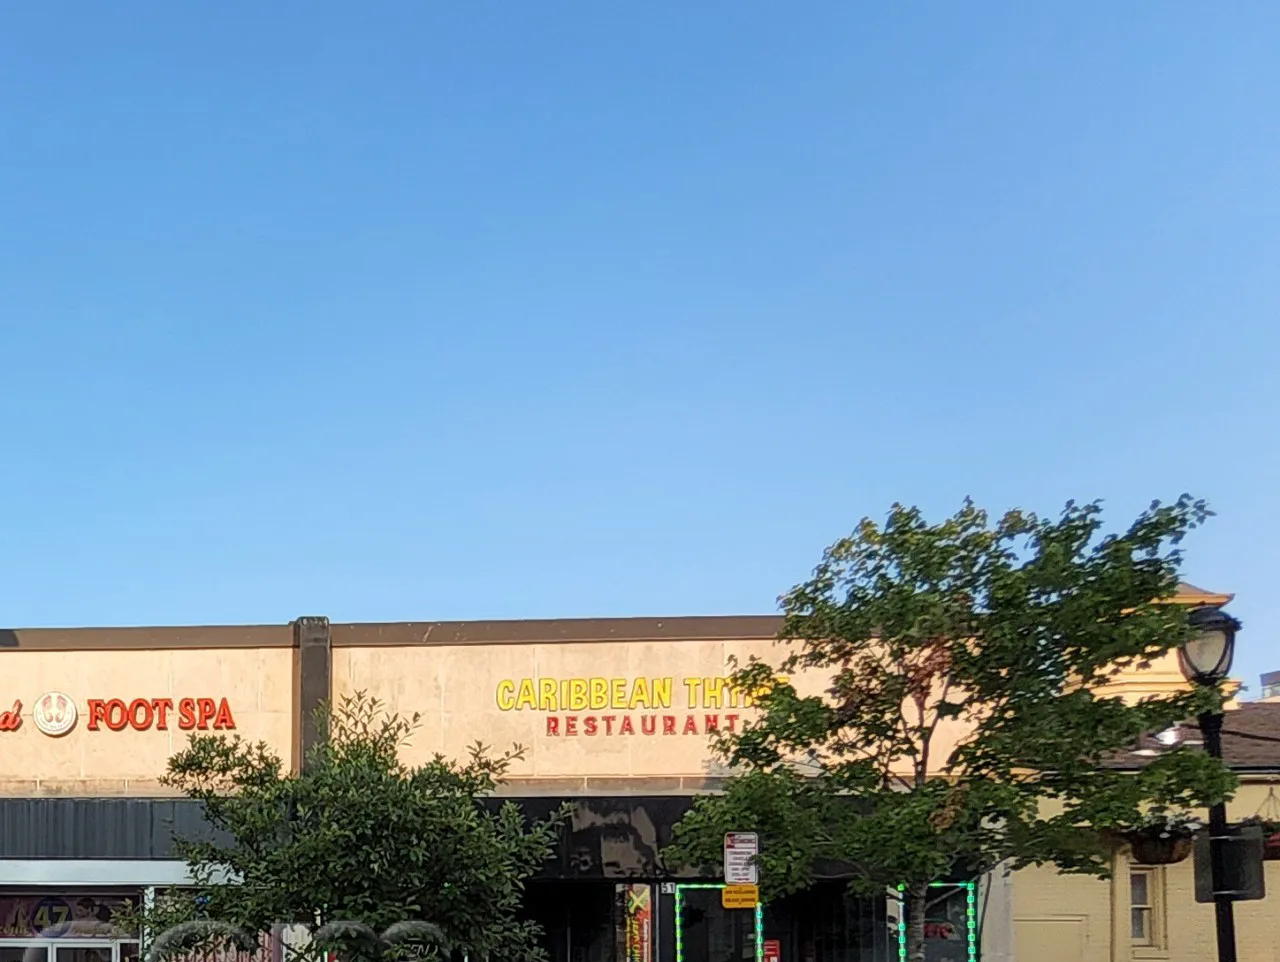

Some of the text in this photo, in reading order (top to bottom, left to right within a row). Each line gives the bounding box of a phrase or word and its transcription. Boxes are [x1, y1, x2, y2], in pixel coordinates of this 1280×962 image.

[496, 677, 673, 712] CARIBBEAN
[87, 697, 237, 730] FOOT SPA
[546, 714, 740, 737] RESTAURANT
[662, 883, 676, 892] 51
[34, 905, 70, 931] 47
